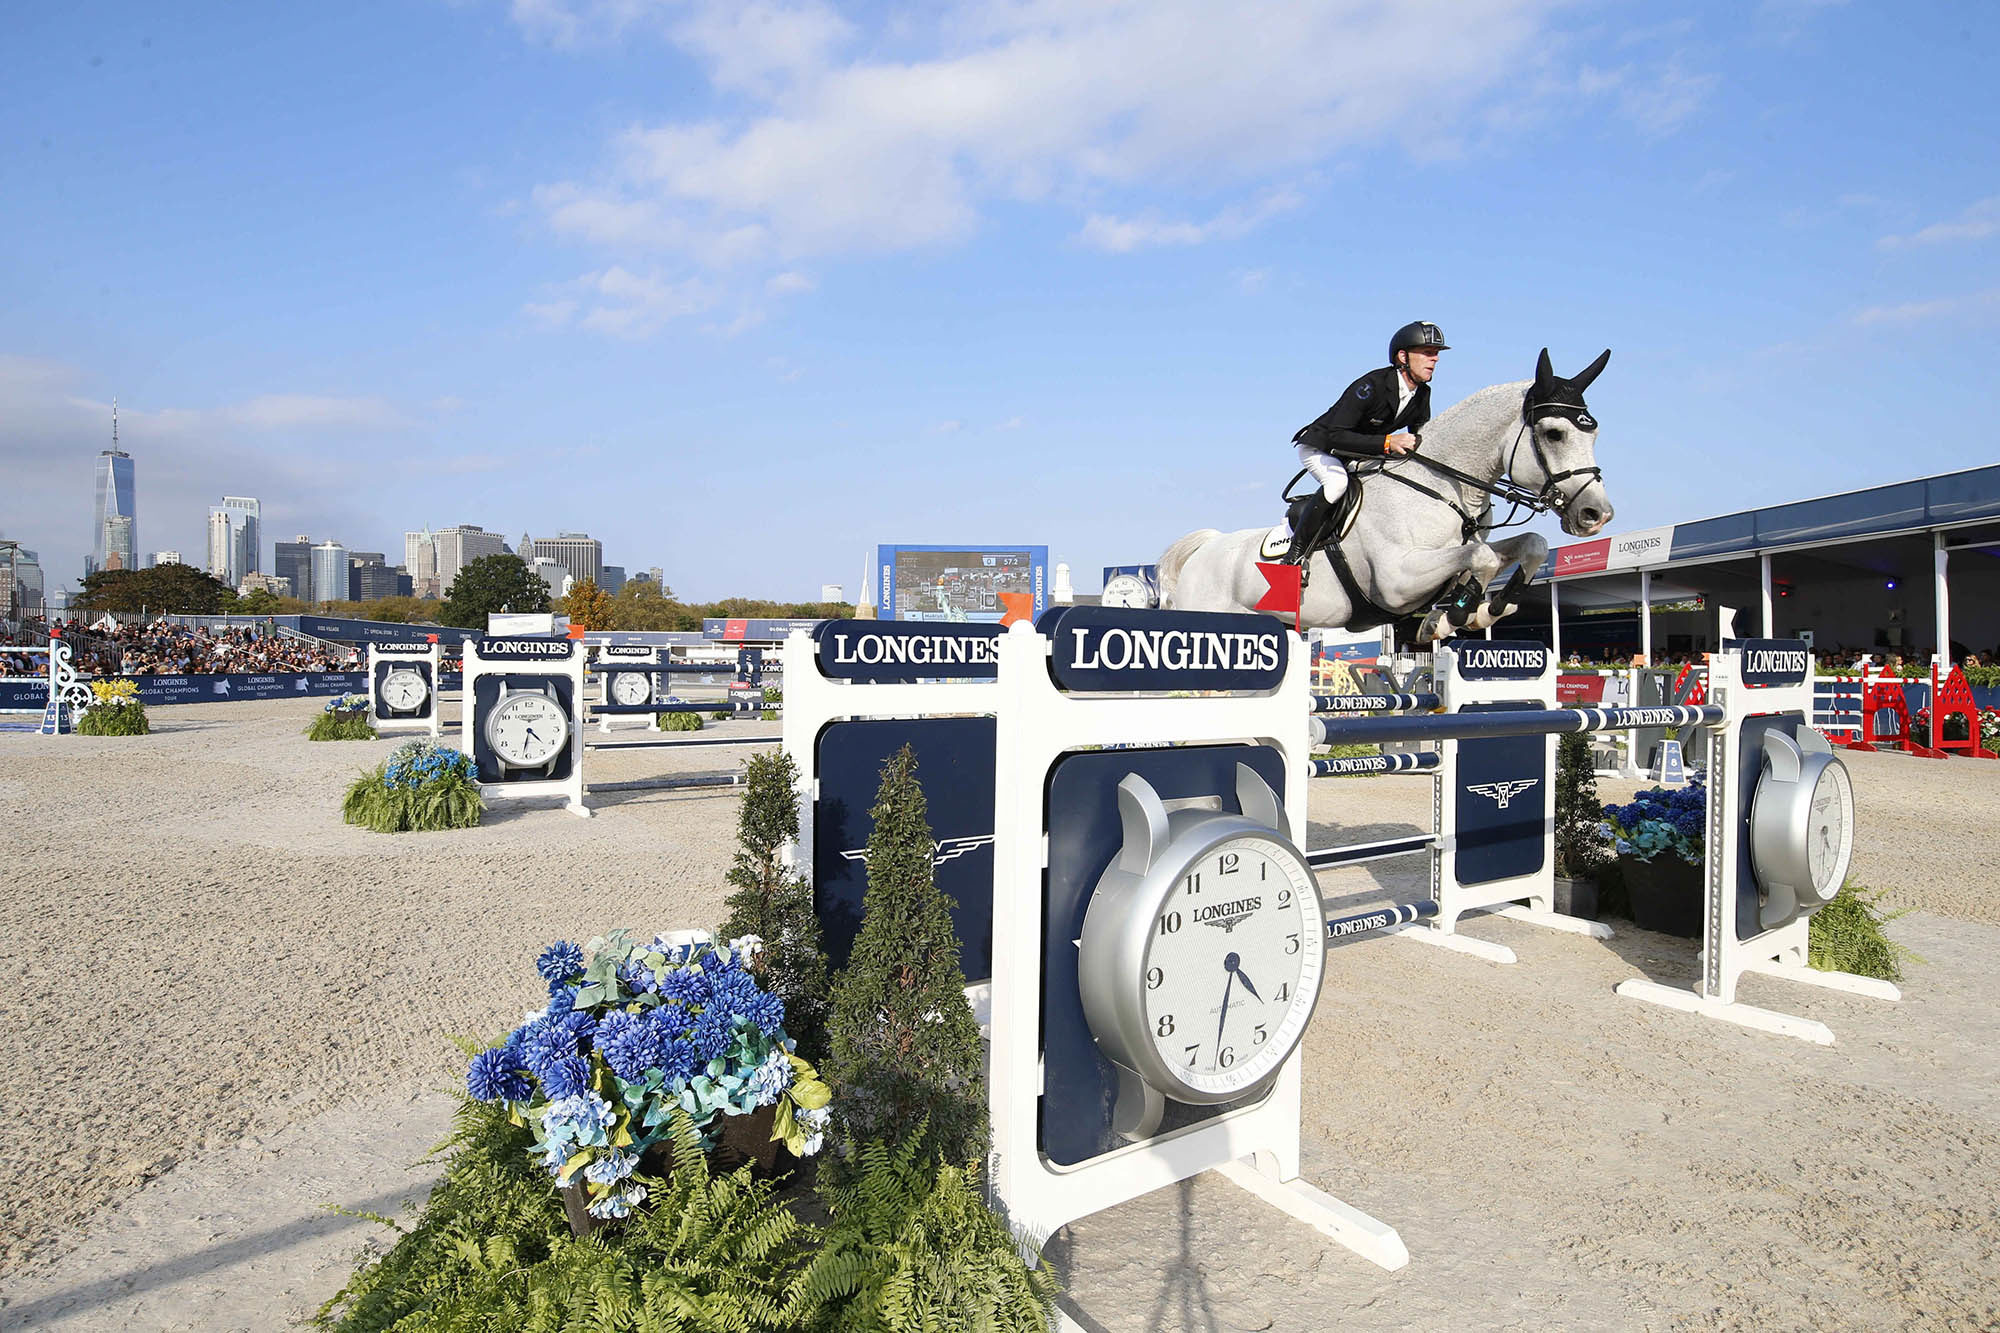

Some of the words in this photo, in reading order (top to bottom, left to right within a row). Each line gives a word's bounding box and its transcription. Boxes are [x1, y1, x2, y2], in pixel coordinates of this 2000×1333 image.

[1270, 538, 1290, 548] nolt
[1618, 537, 1661, 552] LONGINES
[882, 565, 890, 610] LONGINES
[483, 641, 568, 654] LONGINES
[1070, 628, 1279, 671] LONGINES
[1465, 649, 1543, 668] LONGINES
[1747, 650, 1805, 672] LONGINES
[1325, 697, 1386, 709] LONGINES
[1614, 709, 1675, 726] LONGINES
[1324, 757, 1387, 773] LONGINES
[1671, 758, 1678, 767] 8
[1218, 853, 1239, 876] 12
[1260, 861, 1266, 880] 1
[1186, 872, 1200, 894] 11
[1194, 896, 1262, 922] LONGINES
[1278, 890, 1291, 910] 2
[1160, 912, 1182, 935] 10
[1326, 914, 1387, 938] LONGINES
[1285, 933, 1300, 954] 3
[1147, 967, 1164, 990] 9
[1274, 982, 1289, 1002] 4
[1210, 1000, 1245, 1014] AUTMATIC
[1157, 1014, 1175, 1037] 8
[1253, 1023, 1267, 1045] 5
[1185, 1044, 1200, 1066] 7
[1219, 1046, 1234, 1068] 6
